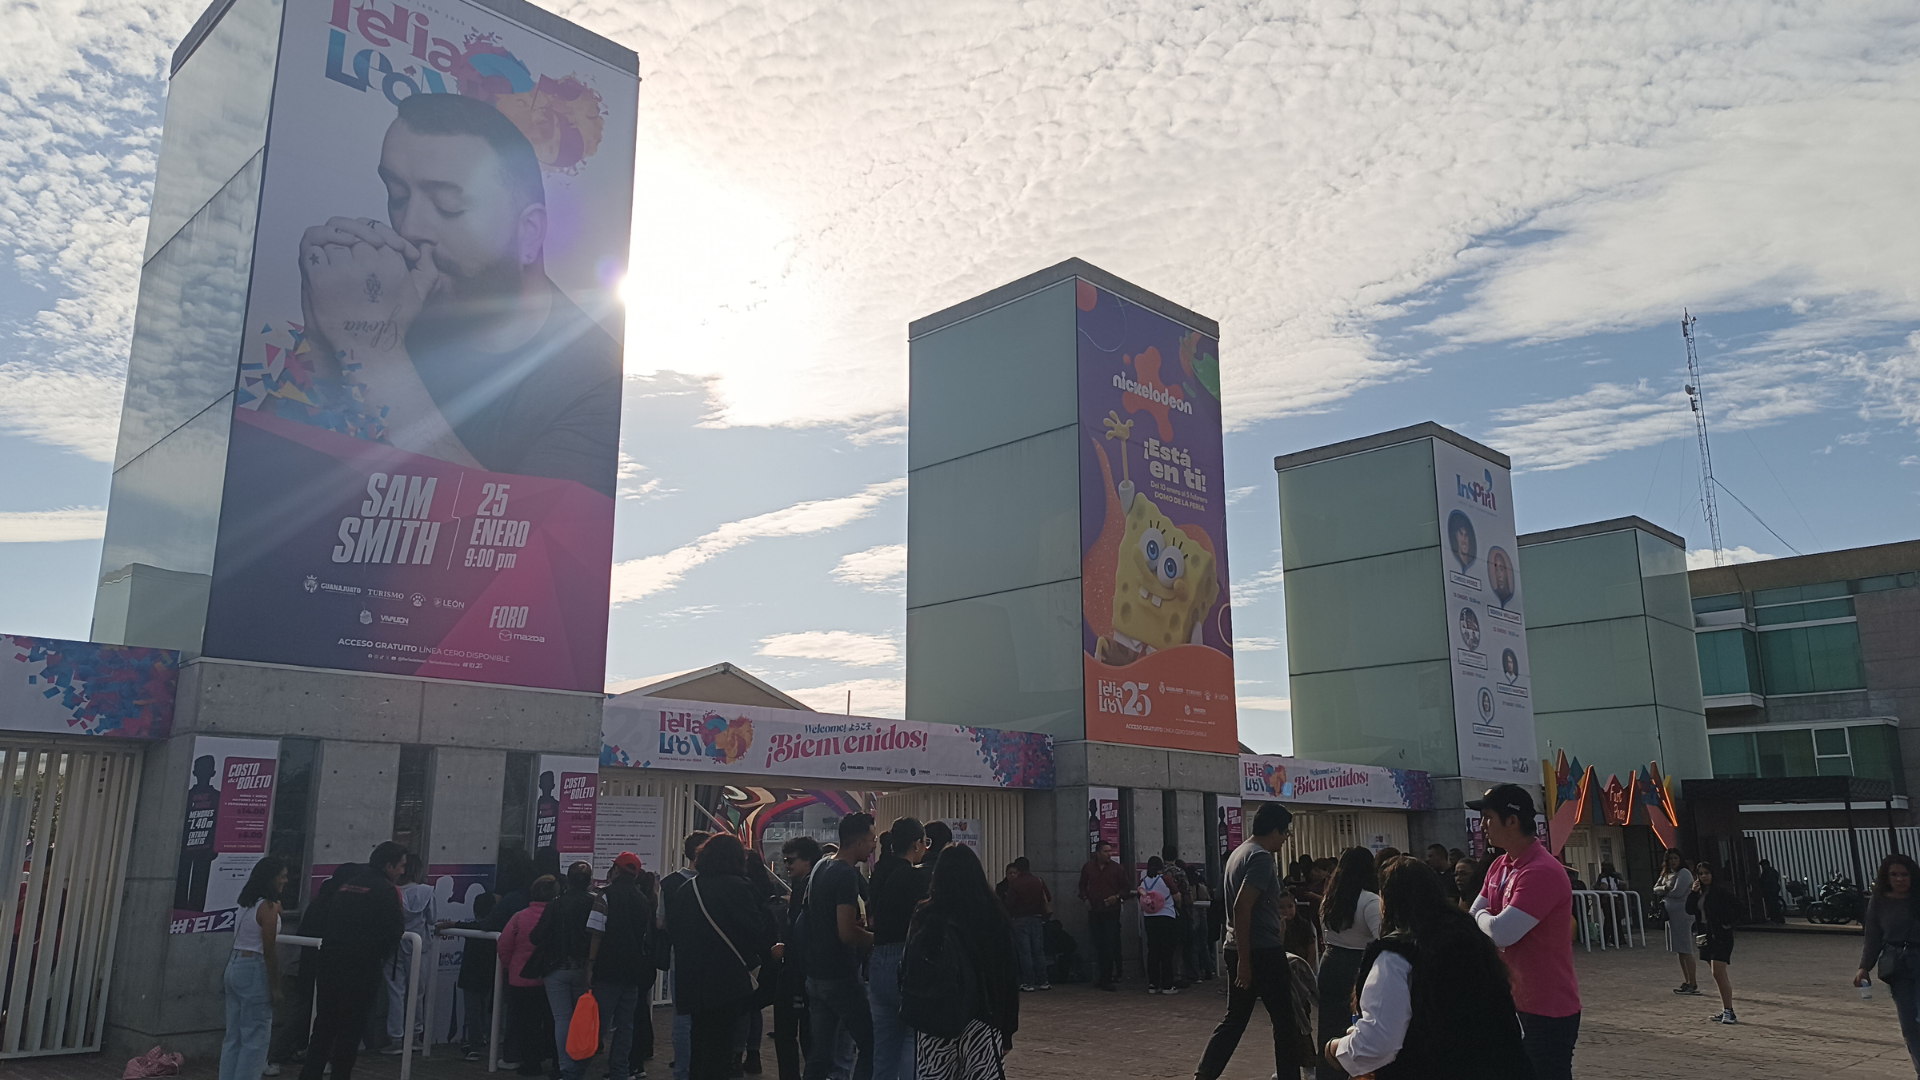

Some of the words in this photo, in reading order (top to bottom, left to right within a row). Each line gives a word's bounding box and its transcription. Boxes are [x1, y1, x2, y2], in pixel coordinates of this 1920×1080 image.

[1112, 371, 1193, 415] nickelodeon
[1143, 438, 1191, 468] ¡Está
[1149, 461, 1179, 484] en
[1184, 468, 1207, 492] ti!
[1150, 480, 1159, 489] Del
[1160, 483, 1166, 491] 10
[361, 472, 438, 520] SAM
[476, 483, 510, 517] 25
[1154, 491, 1173, 503] DOMO
[1173, 496, 1181, 505] DE
[1181, 499, 1189, 507] LA
[1189, 502, 1206, 512] FERIA
[331, 517, 441, 565] SMITH
[469, 518, 531, 548] ENERO
[464, 548, 494, 568] 9:00
[494, 552, 517, 571] pm
[320, 582, 361, 594] GUANAJUATO
[367, 588, 404, 600] TURISMO
[442, 597, 465, 609] LEÓN
[489, 605, 529, 629] FORO
[513, 633, 546, 643] mazda
[338, 637, 374, 648] ACCESO
[375, 641, 418, 653] GRATUITO
[418, 645, 442, 655] LÍNEA
[443, 649, 465, 658] CERO
[466, 652, 510, 663] DISPONIBLE
[1122, 681, 1152, 717] 25
[805, 723, 846, 734] Welcome!
[848, 722, 873, 732] ようこそ
[1142, 725, 1163, 733] GRATUITO
[765, 724, 928, 768] ¡Bienvenidos!
[228, 763, 261, 777] COSTO
[236, 775, 272, 790] BOLETO
[564, 777, 587, 790] COSTO
[570, 786, 595, 800] BOLETO
[1293, 768, 1369, 800] ¡Bienvenidos!
[189, 809, 214, 819] MENORES
[187, 838, 205, 846] GRATIS
[188, 830, 208, 839] ENTRAN
